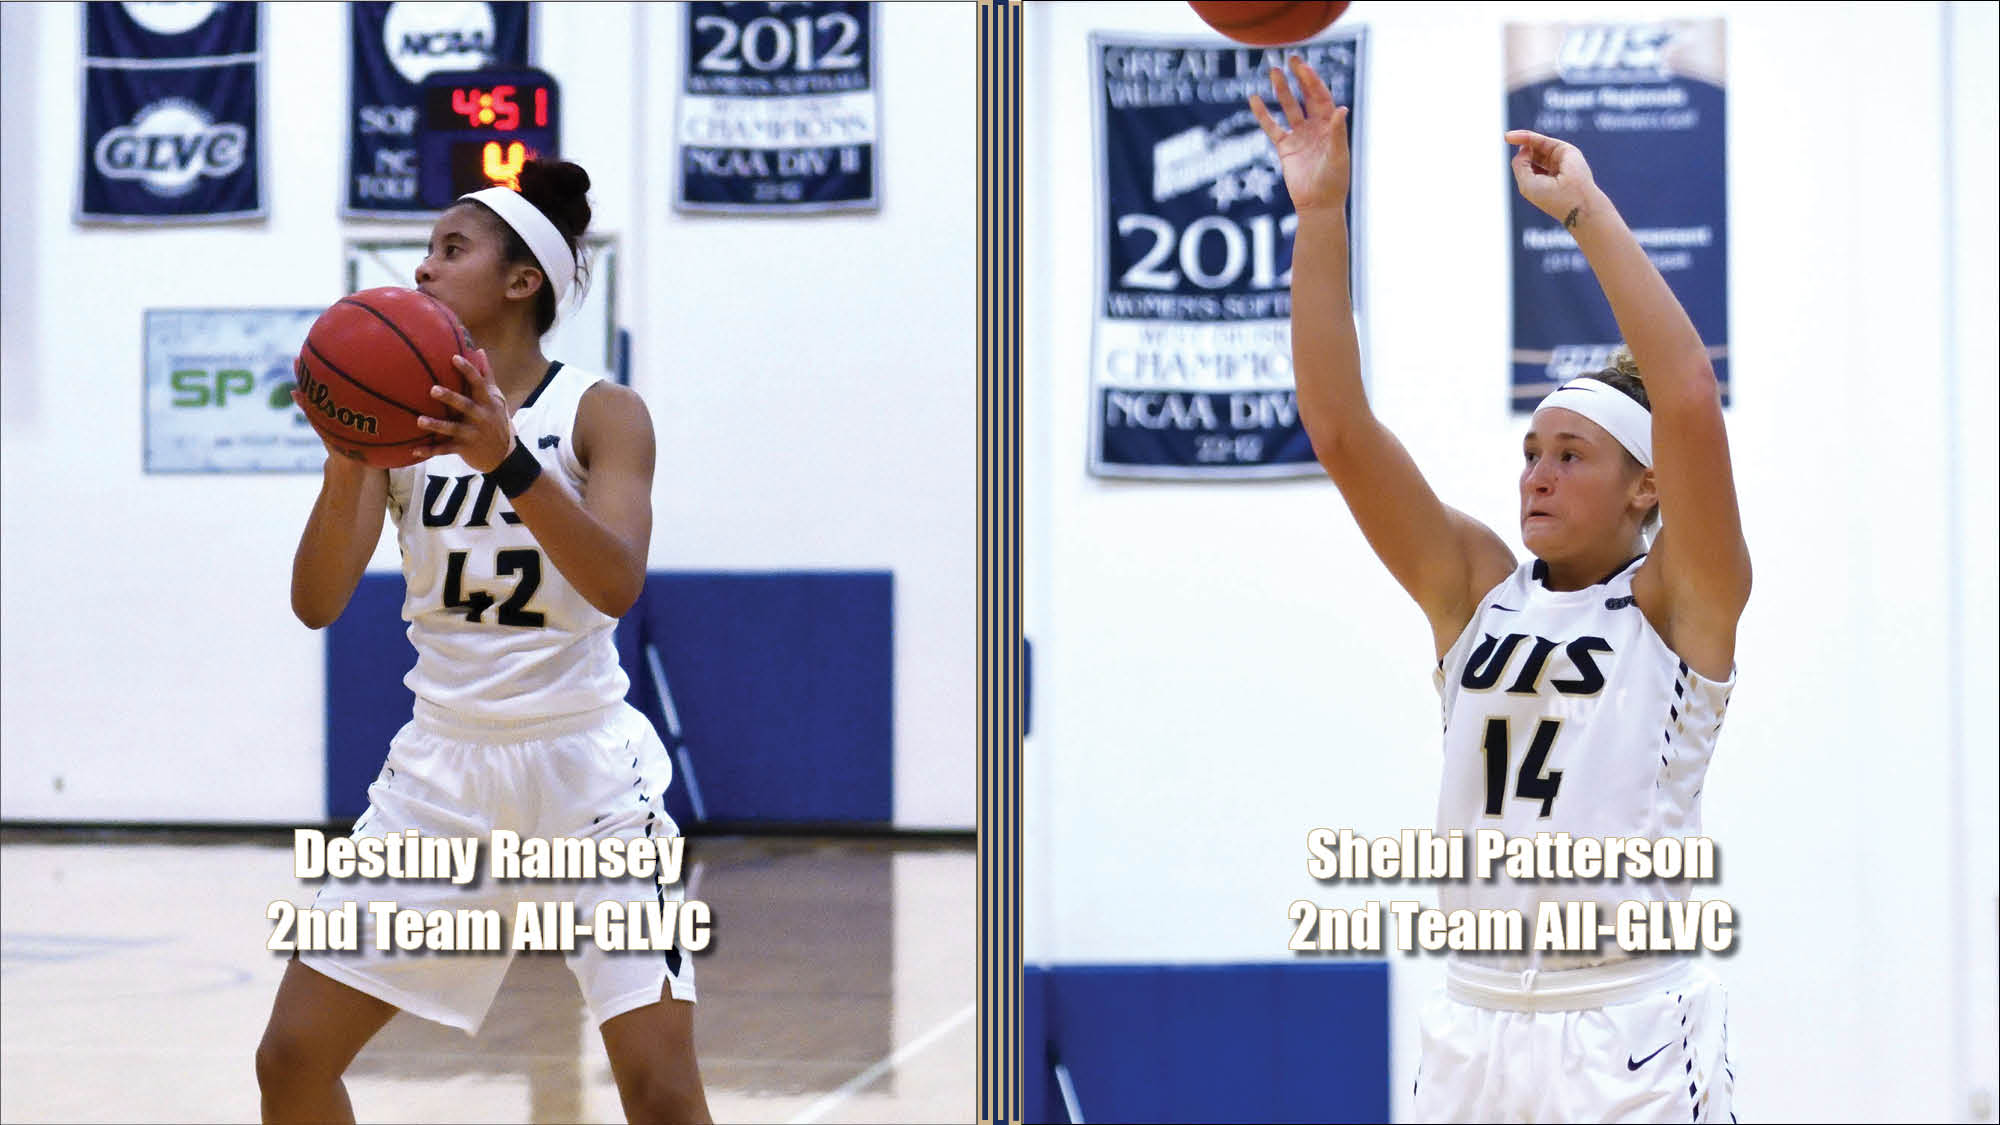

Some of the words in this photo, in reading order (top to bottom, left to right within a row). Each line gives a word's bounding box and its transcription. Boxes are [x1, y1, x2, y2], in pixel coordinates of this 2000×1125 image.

[403, 31, 491, 53] NCAA
[695, 12, 863, 72] 2012
[1106, 50, 1221, 79] GREAT
[452, 85, 549, 131] 4:51
[101, 129, 243, 175] GLVC
[690, 150, 769, 177] NCAA
[1106, 390, 1218, 430] NCAA
[443, 548, 545, 628] 42
[1459, 632, 1615, 697] UIS
[1481, 715, 1564, 820] 14
